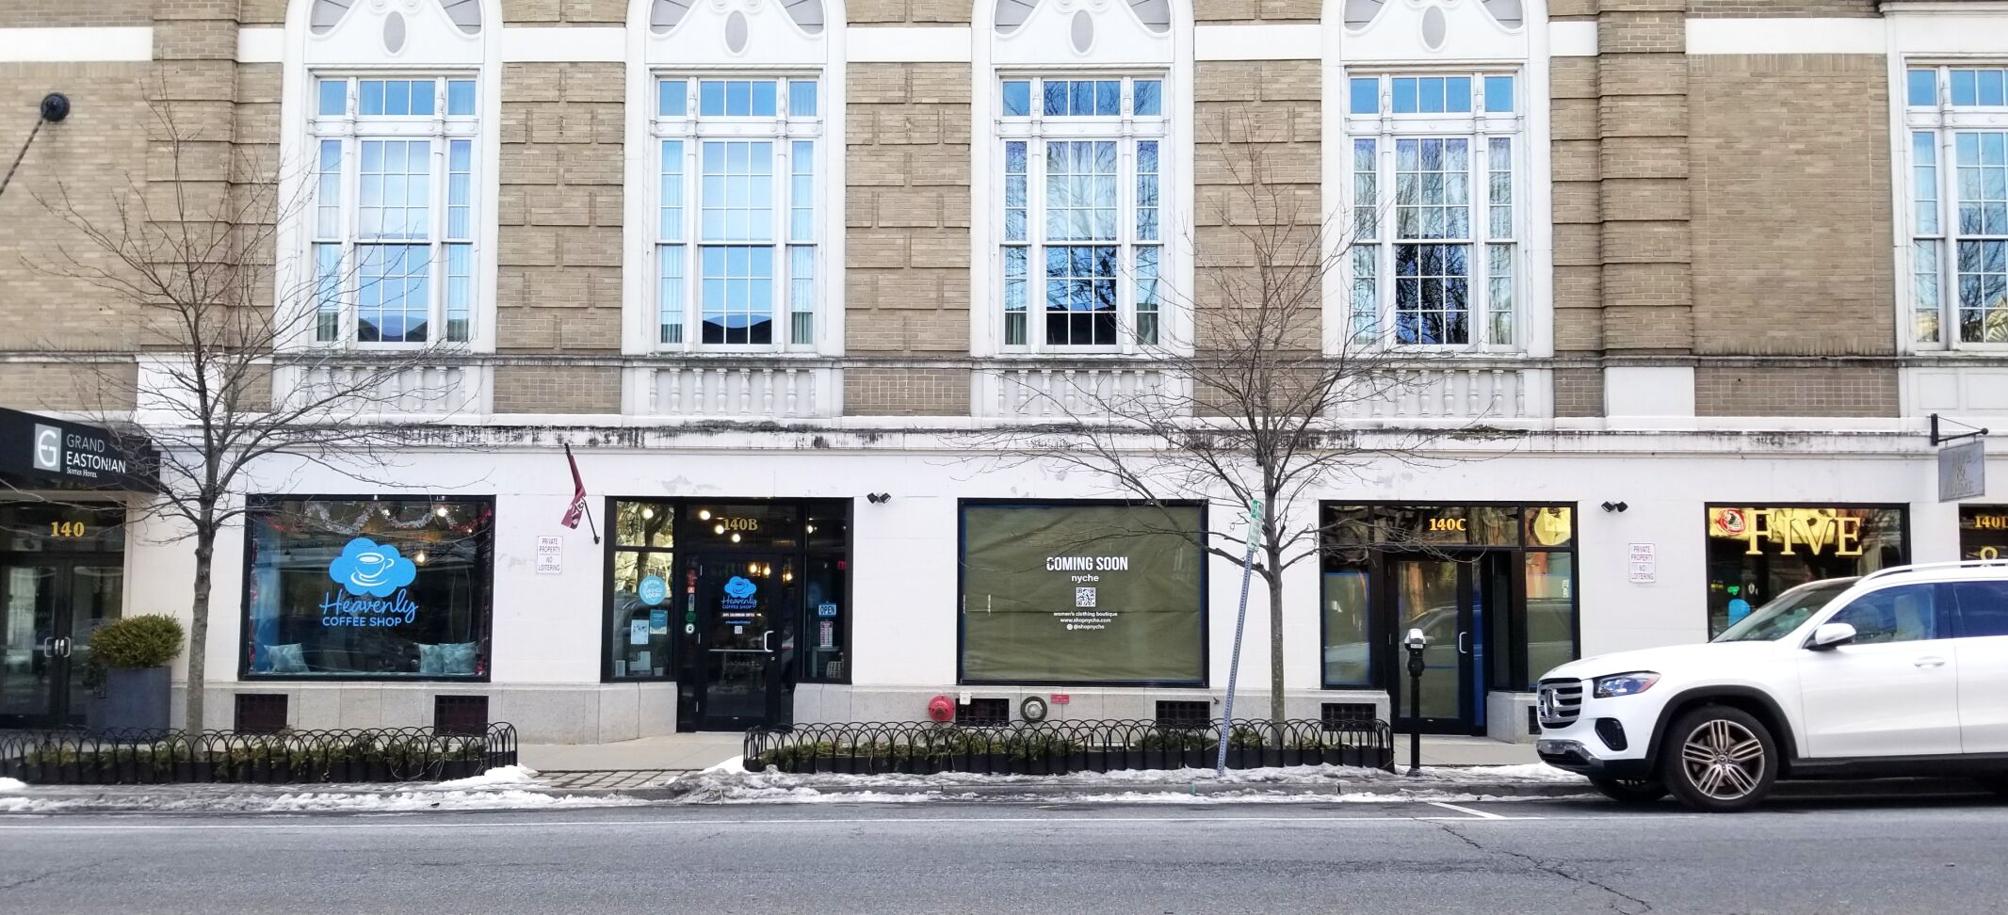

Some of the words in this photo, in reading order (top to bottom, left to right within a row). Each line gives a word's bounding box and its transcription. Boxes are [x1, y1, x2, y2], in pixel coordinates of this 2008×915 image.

[66, 434, 105, 453] GRAND
[66, 451, 126, 473] EASTONIAN
[51, 521, 85, 537] 140
[723, 518, 758, 530] 140B
[1429, 518, 1467, 531] 140C
[1745, 509, 1863, 556] FIVE
[1046, 556, 1093, 571] COMING
[1096, 556, 1128, 571] SOON
[1071, 574, 1099, 584] nyche
[319, 588, 419, 624] Heavenly
[820, 605, 835, 615] OPEN
[322, 616, 366, 626] COFFEE
[369, 616, 402, 626] SHOP
